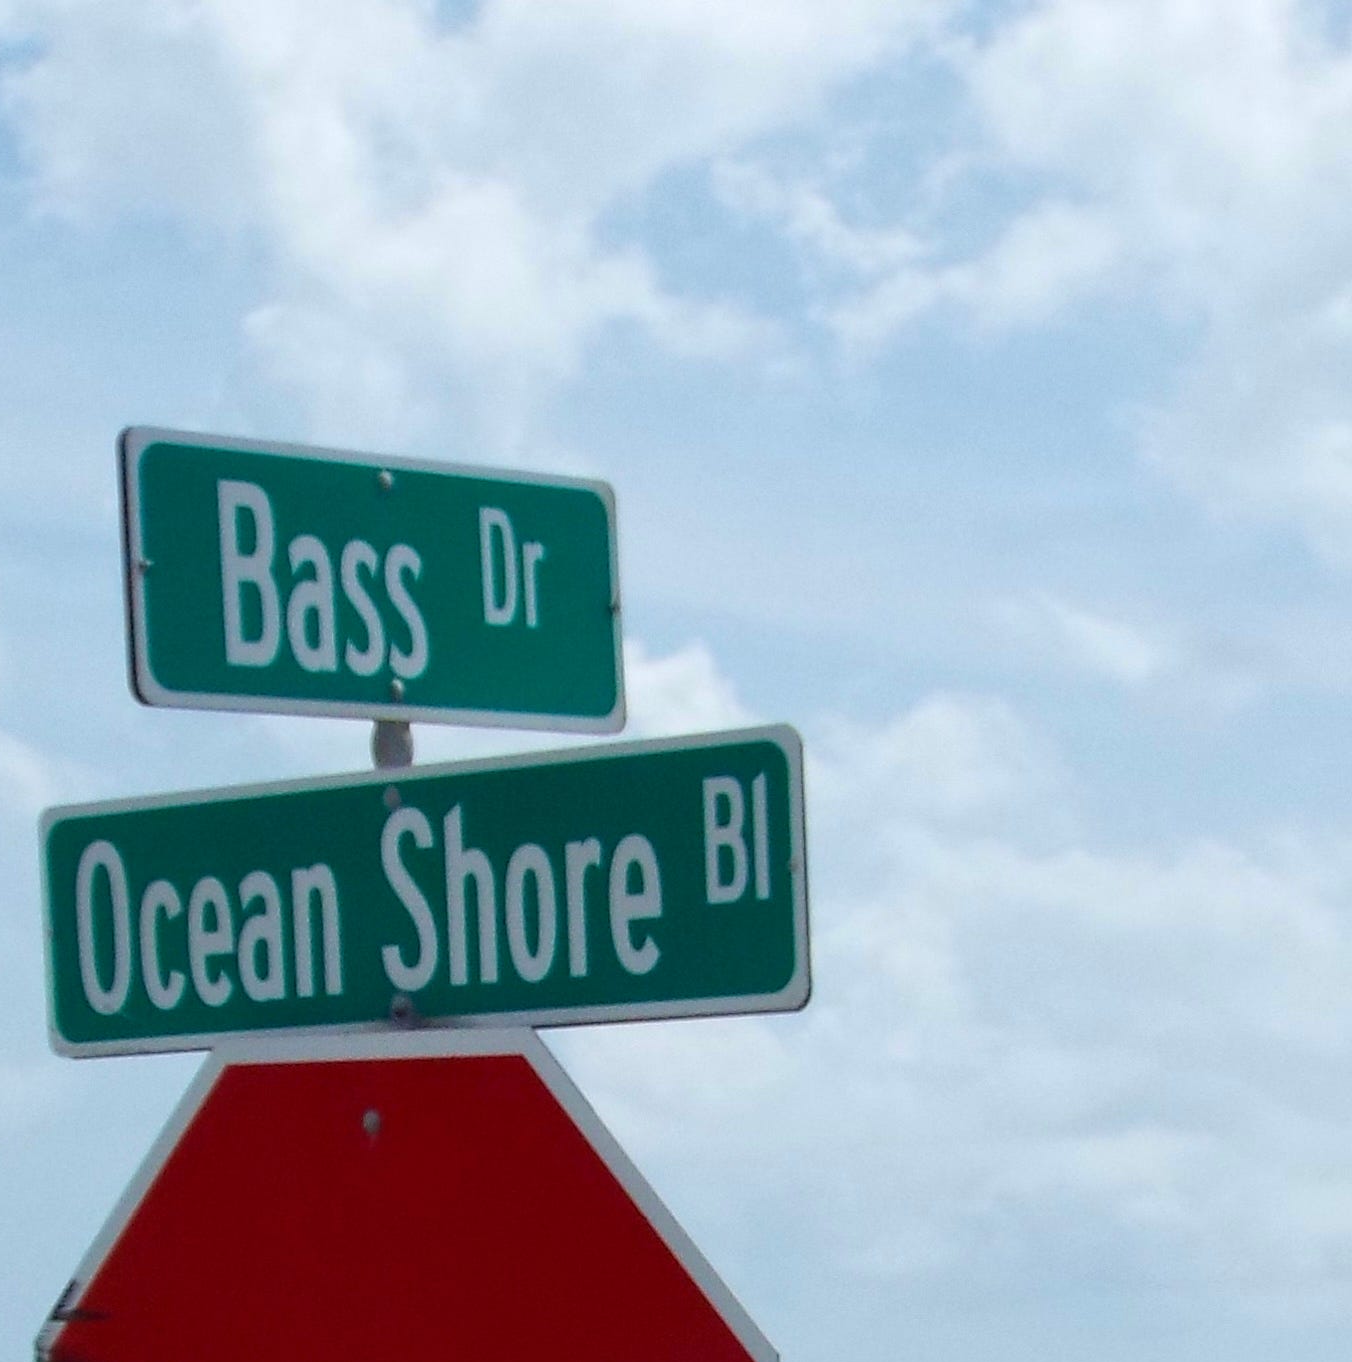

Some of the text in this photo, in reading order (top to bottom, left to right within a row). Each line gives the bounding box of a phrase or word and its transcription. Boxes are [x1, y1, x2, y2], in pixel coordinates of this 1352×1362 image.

[216, 478, 545, 680] Bass Dr
[74, 771, 771, 1016] Ocean Shore Bl
